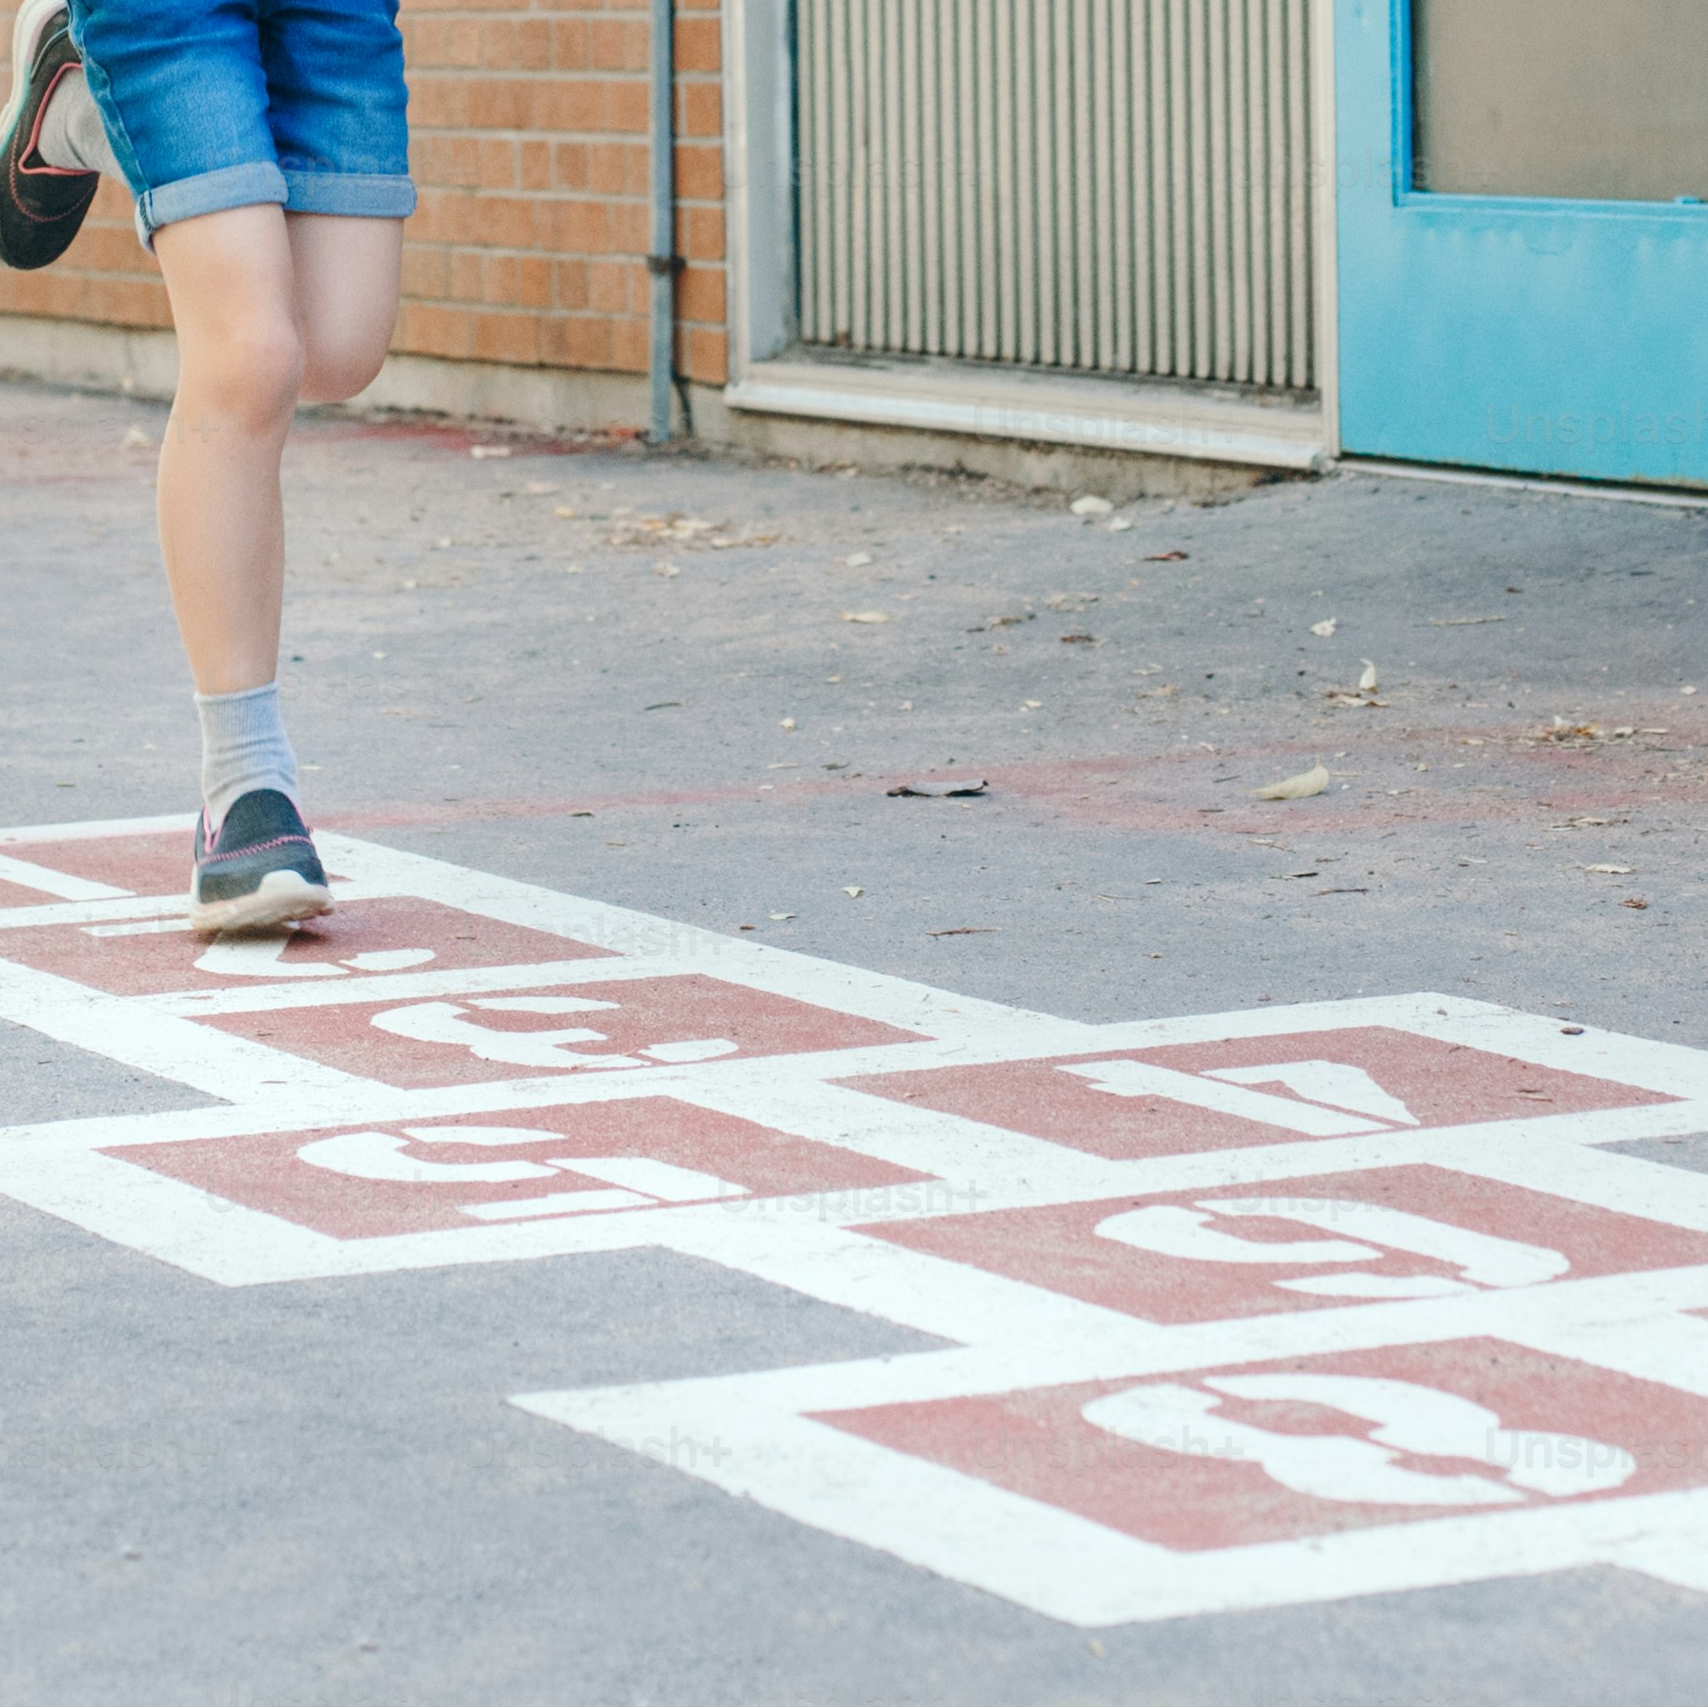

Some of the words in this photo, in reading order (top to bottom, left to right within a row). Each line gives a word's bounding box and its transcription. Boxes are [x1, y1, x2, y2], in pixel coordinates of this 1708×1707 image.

[370, 995, 740, 1070] 3
[1052, 1058, 1422, 1138] 4
[295, 1125, 755, 1221] 5
[1081, 1372, 1637, 1506] 8
